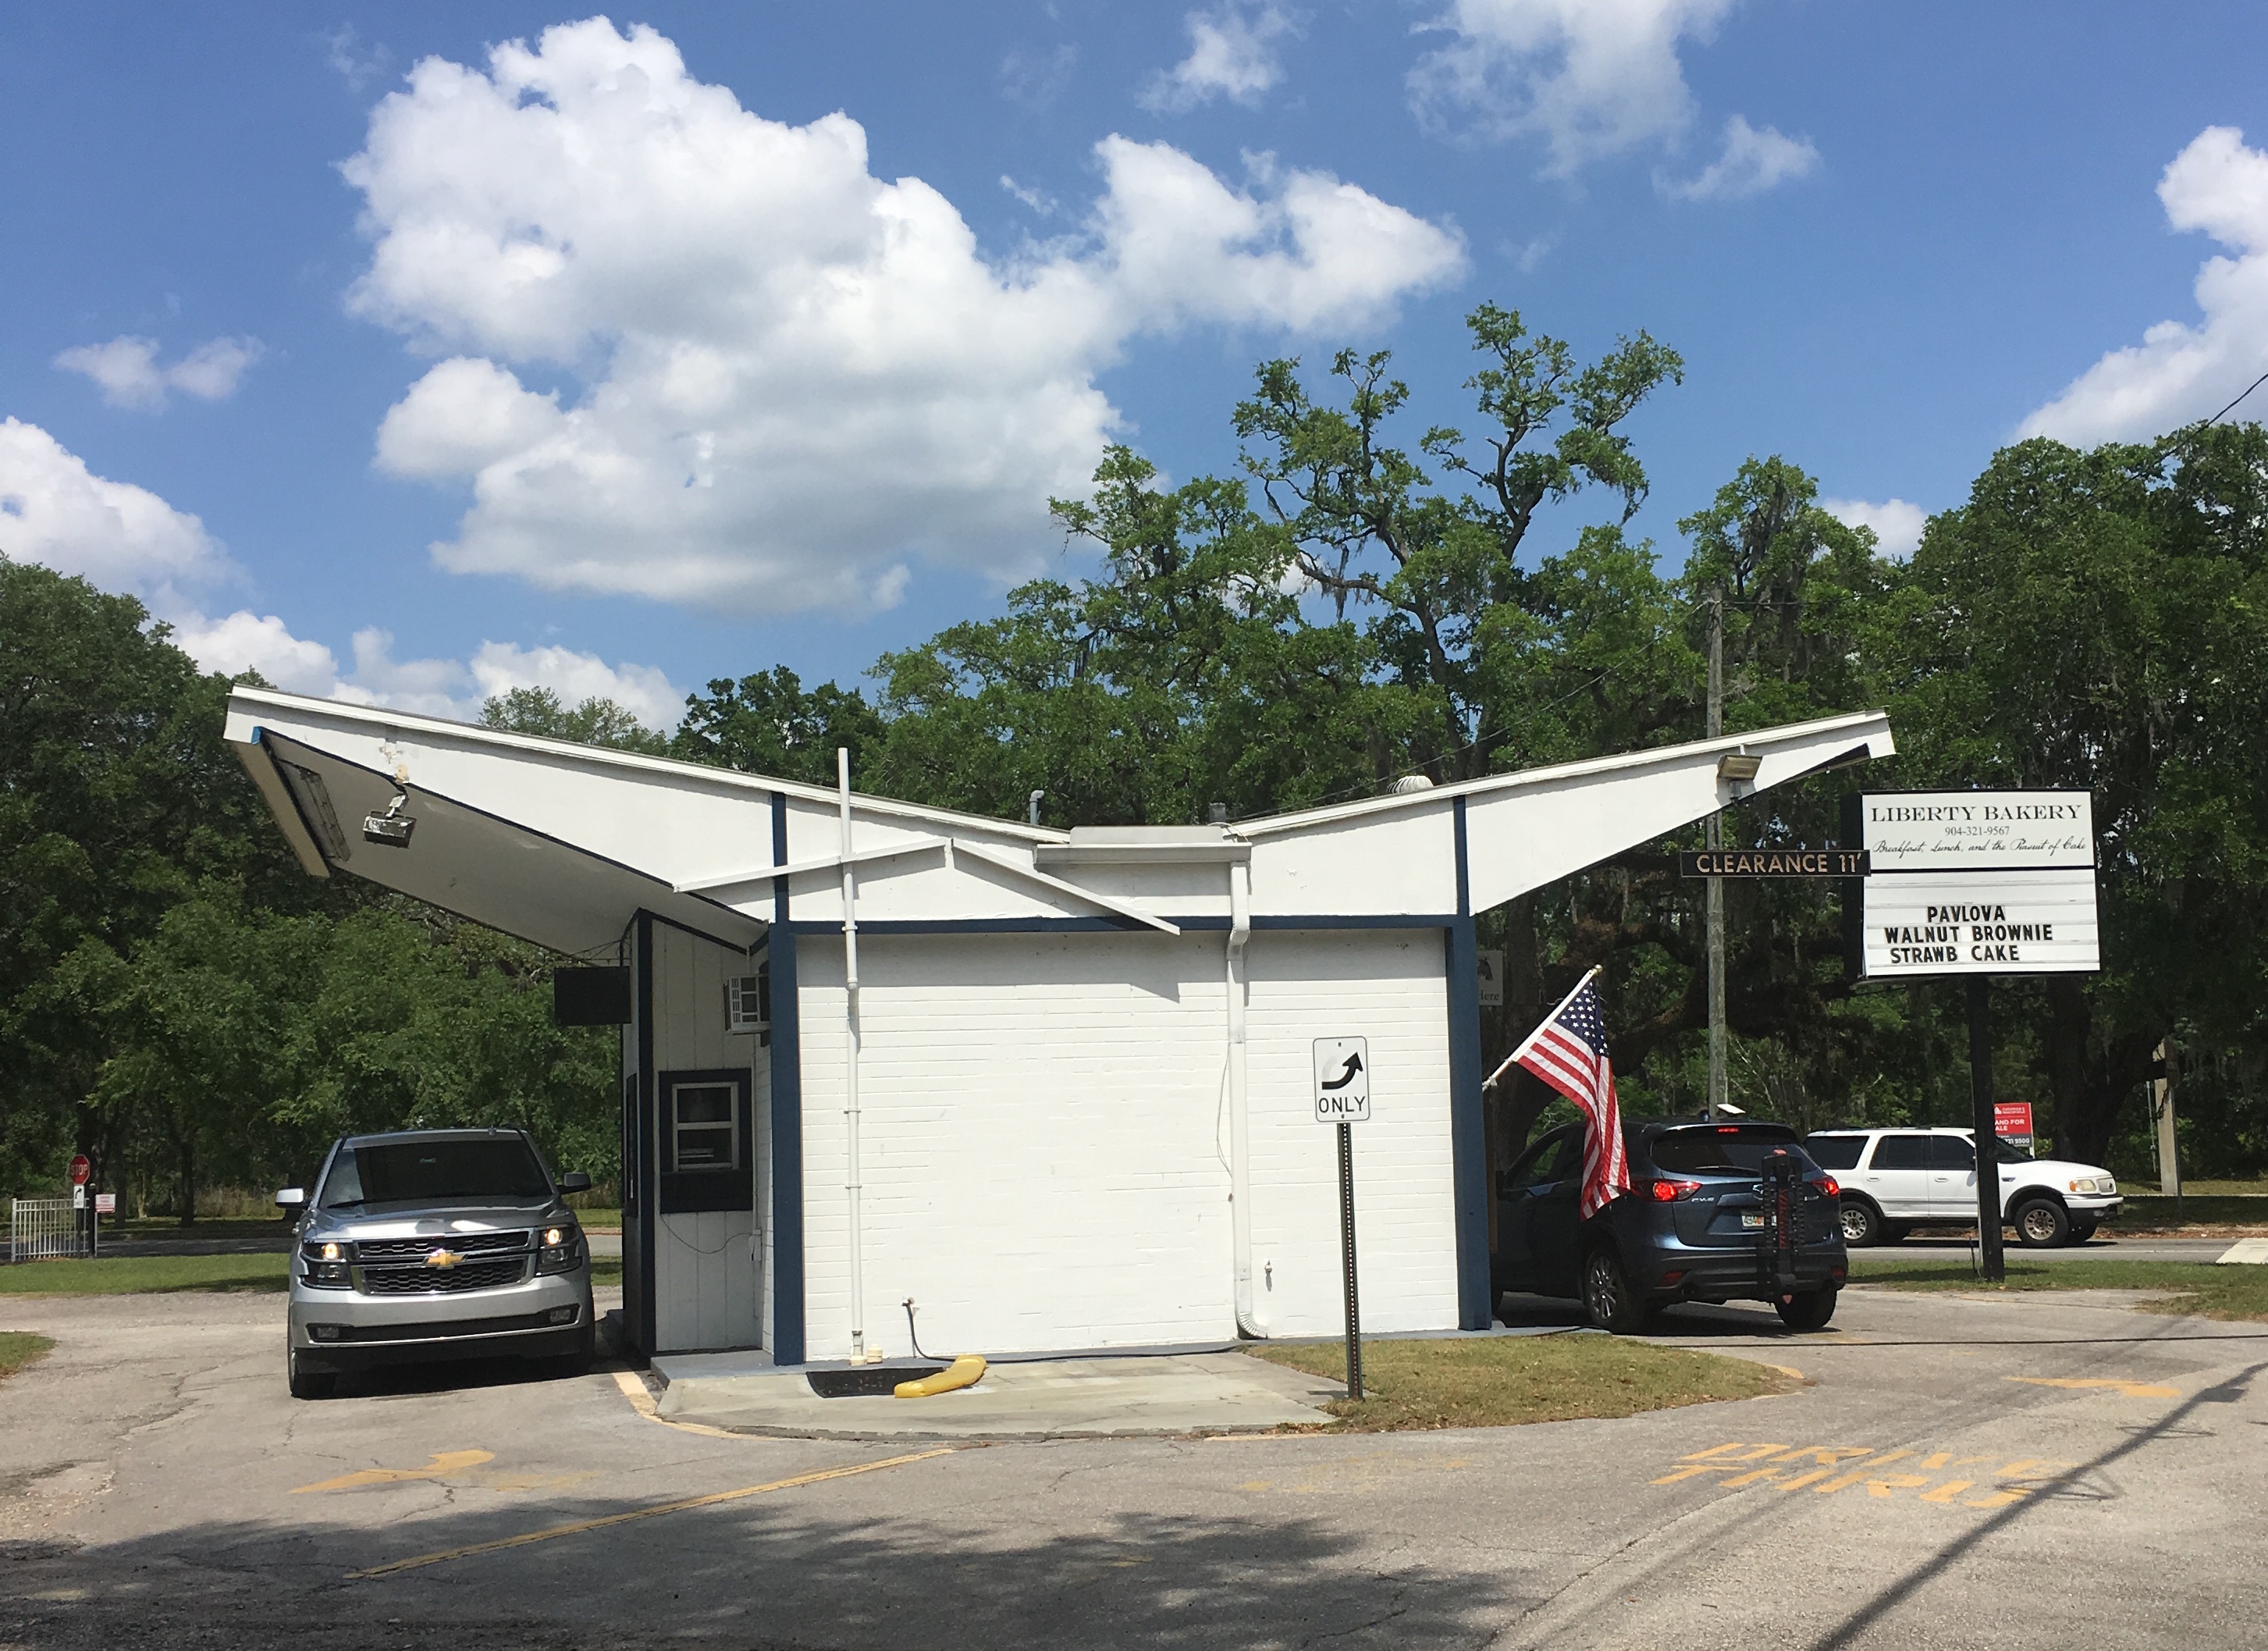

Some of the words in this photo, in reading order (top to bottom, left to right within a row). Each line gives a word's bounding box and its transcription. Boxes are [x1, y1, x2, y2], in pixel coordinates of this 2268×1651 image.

[1871, 806, 1977, 822] LIBERTY
[1983, 805, 2081, 820] BAKERY
[1945, 826, 2010, 837] 904-321-9567
[1872, 839, 1927, 859] Breakfast,
[1968, 839, 1991, 852] and
[1991, 839, 2007, 851] the
[2048, 838, 2063, 856] of
[2063, 835, 2086, 850] Cake
[1696, 854, 1828, 873] CLEARANCE
[1838, 852, 1862, 873] 11'
[1927, 906, 2006, 923] PAVLOVA
[1885, 926, 1961, 944] WALNUT
[1971, 924, 2053, 941] BROWNIE
[1889, 945, 1958, 963] STRAWB
[1971, 945, 2020, 961] CAKE
[1318, 1096, 1366, 1113] ONLY
[70, 1164, 88, 1176] STOP
[1648, 1464, 2034, 1509] THRU
